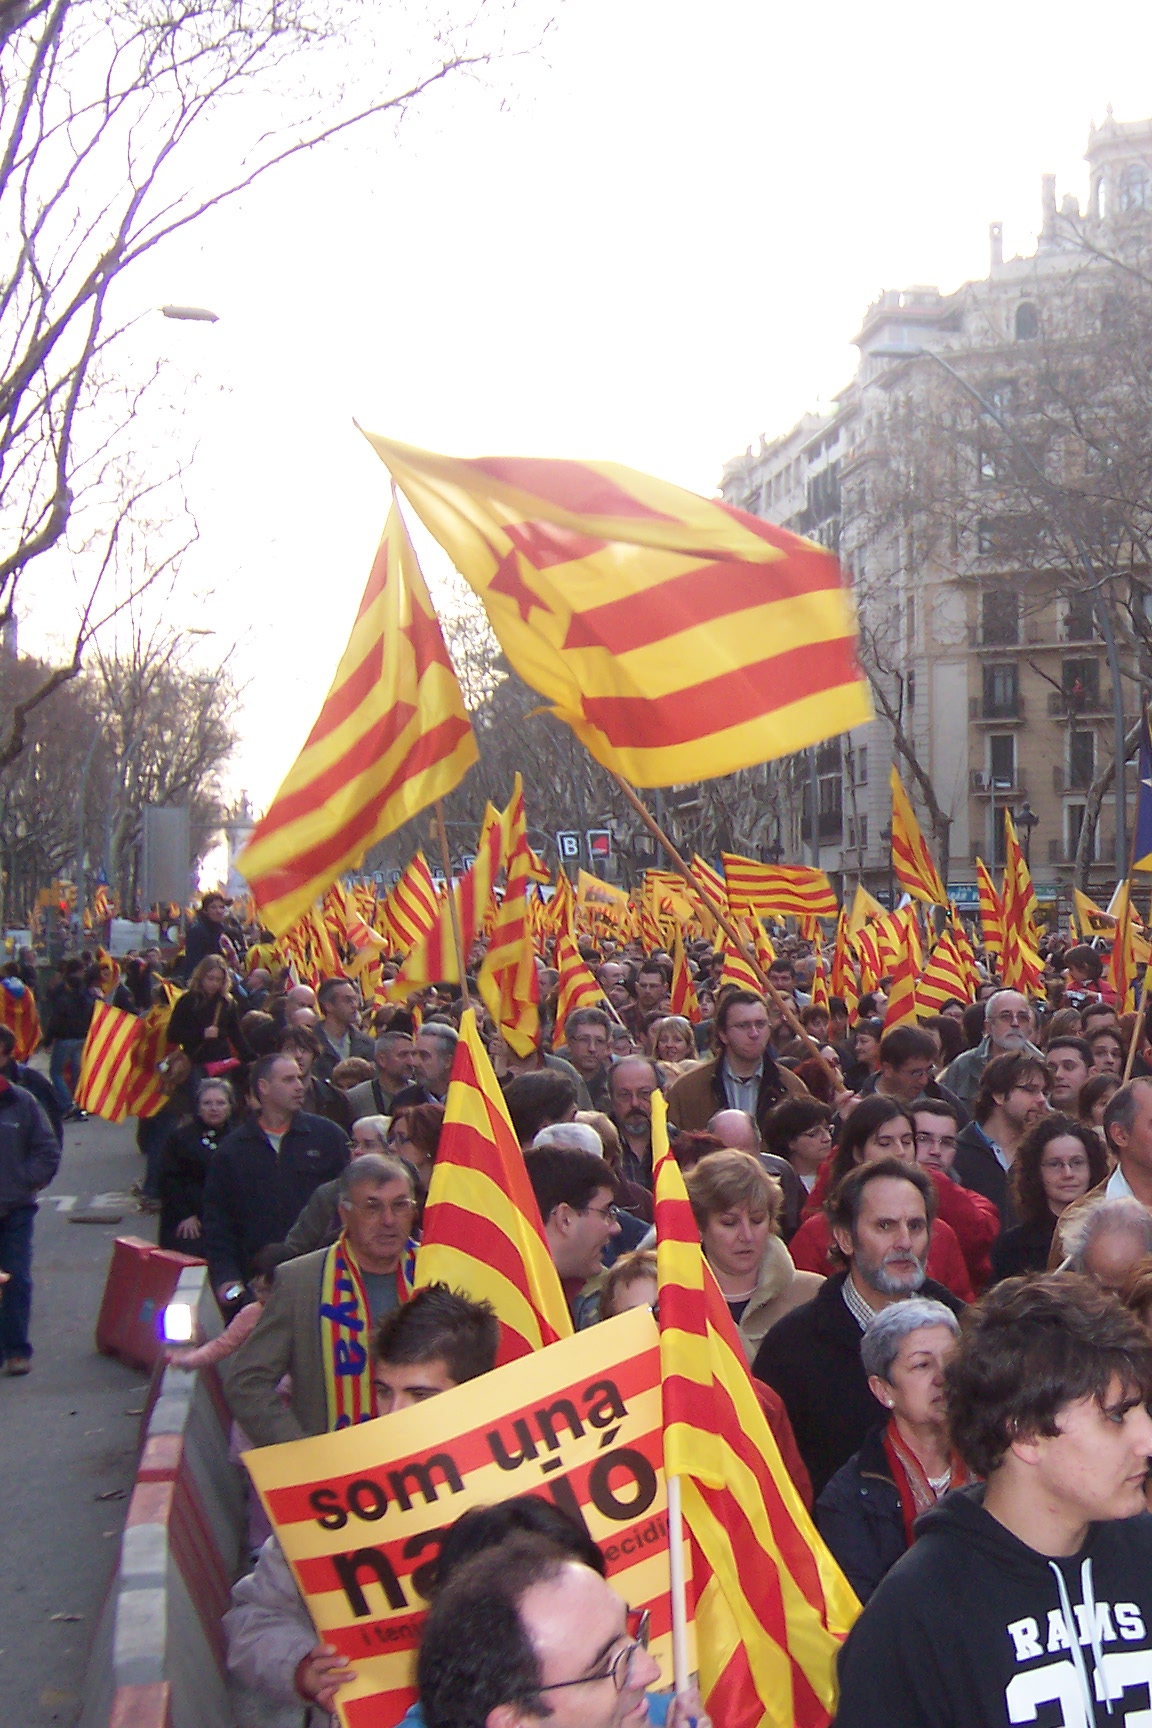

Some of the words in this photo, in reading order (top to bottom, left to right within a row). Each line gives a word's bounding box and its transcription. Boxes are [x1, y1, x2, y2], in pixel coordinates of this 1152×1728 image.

[309, 1452, 464, 1530] som
[487, 1379, 629, 1471] una
[1006, 1602, 1146, 1662] RAMS
